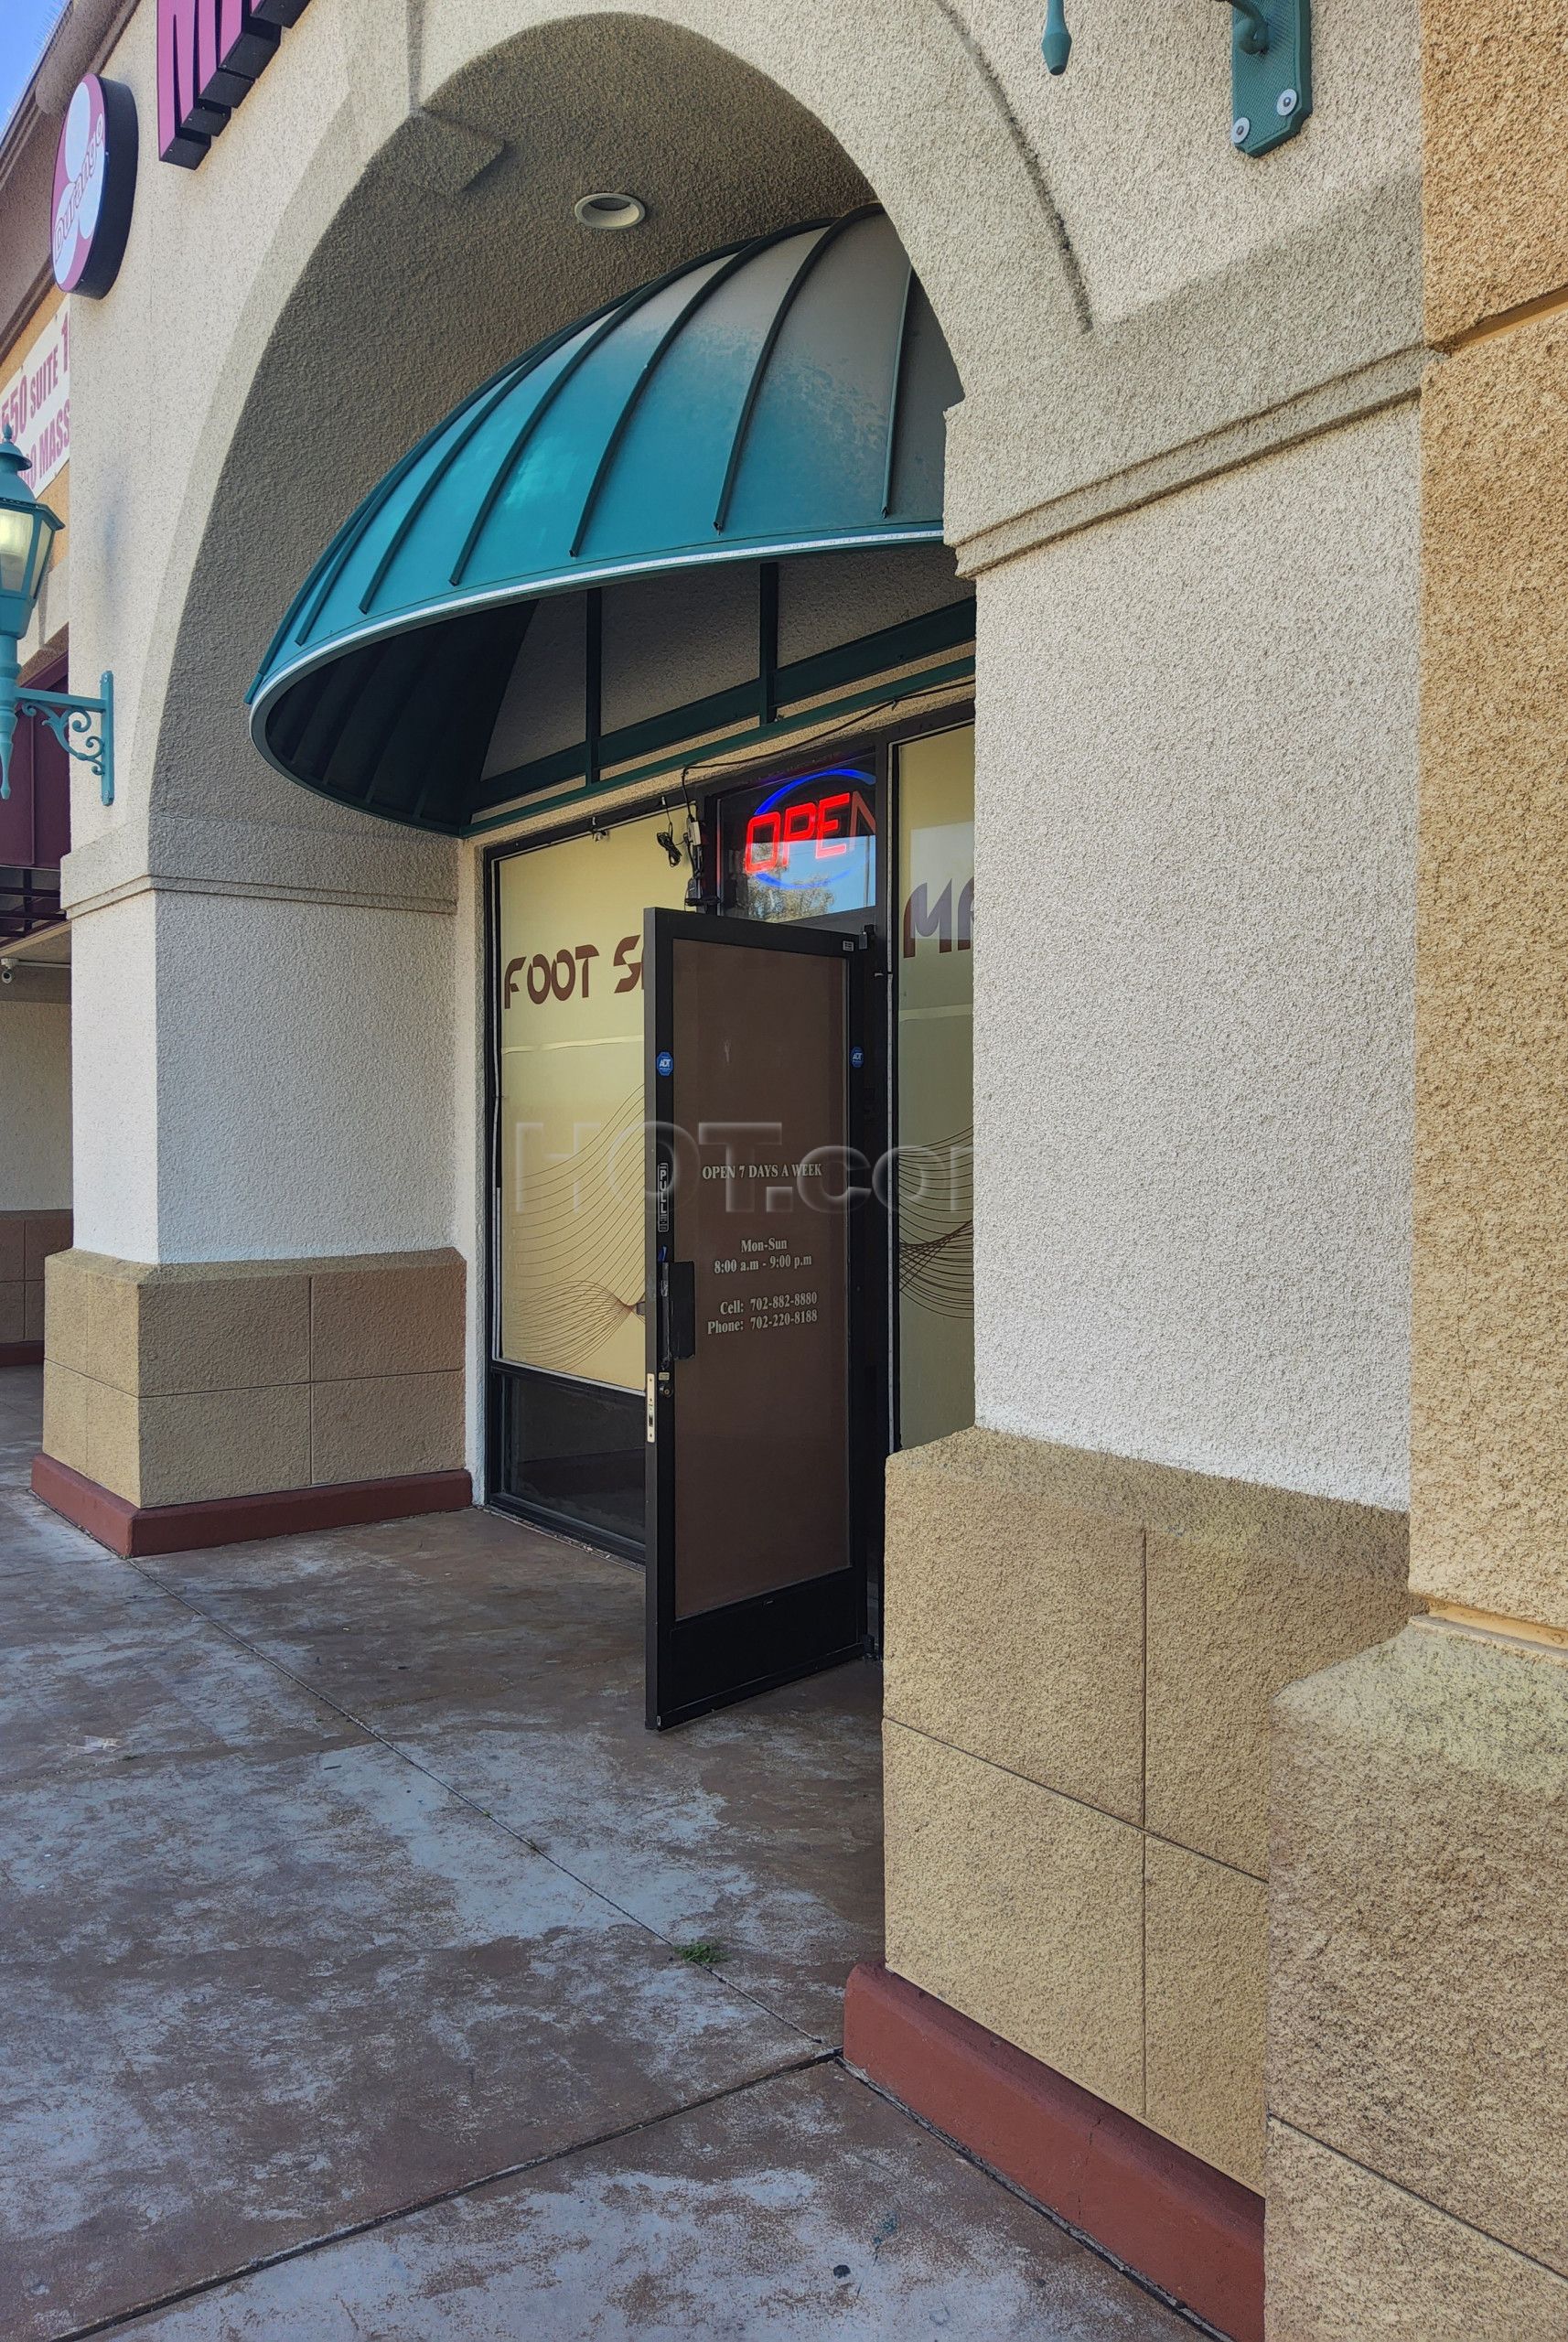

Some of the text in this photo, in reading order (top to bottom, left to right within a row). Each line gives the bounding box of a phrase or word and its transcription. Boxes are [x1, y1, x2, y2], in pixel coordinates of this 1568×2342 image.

[54, 113, 103, 265] Durango
[30, 344, 59, 419] SUITE
[745, 790, 875, 874] OPEN
[504, 934, 644, 1009] FOOT S
[702, 1163, 822, 1179] OPEN 7 DAYS A WEEK
[741, 1238, 788, 1252] Mon-Sun
[714, 1260, 737, 1273] 8:00
[740, 1259, 759, 1272] a.m
[769, 1254, 791, 1269] 9:00
[794, 1255, 812, 1269] p.m
[720, 1291, 818, 1316] Cell: 702-882-8880
[707, 1309, 818, 1335] Phone: 702-220-8188
